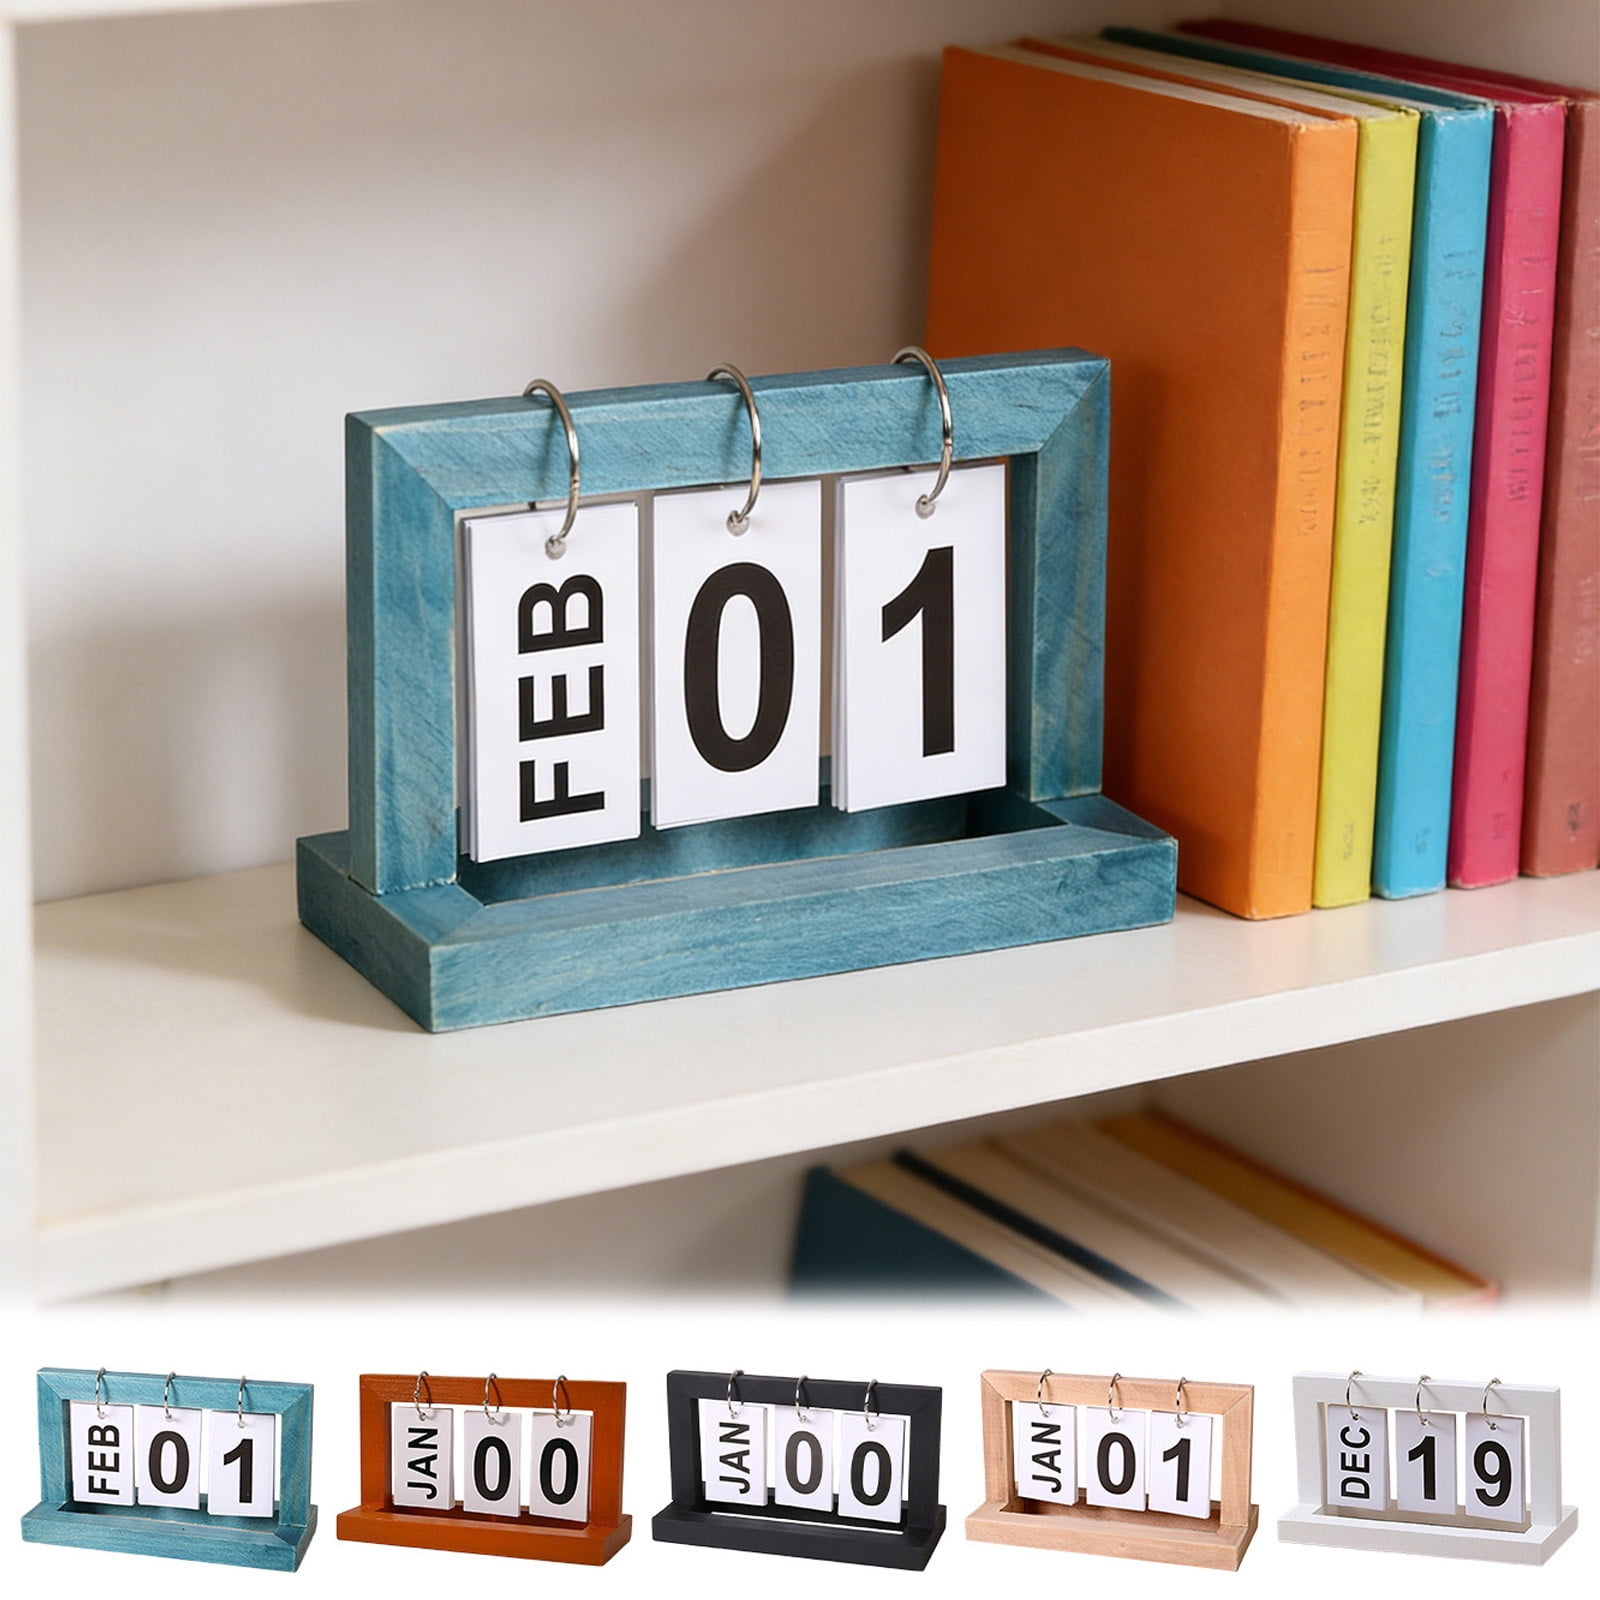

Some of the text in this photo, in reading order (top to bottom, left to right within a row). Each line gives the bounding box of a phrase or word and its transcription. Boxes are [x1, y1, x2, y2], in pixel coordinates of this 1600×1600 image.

[518, 574, 605, 823] FEB
[88, 1424, 120, 1496] FEB
[407, 1427, 438, 1500] JAN
[719, 1422, 750, 1495] JAN
[1031, 1422, 1062, 1494] JAN
[1340, 1424, 1371, 1500] DEC
